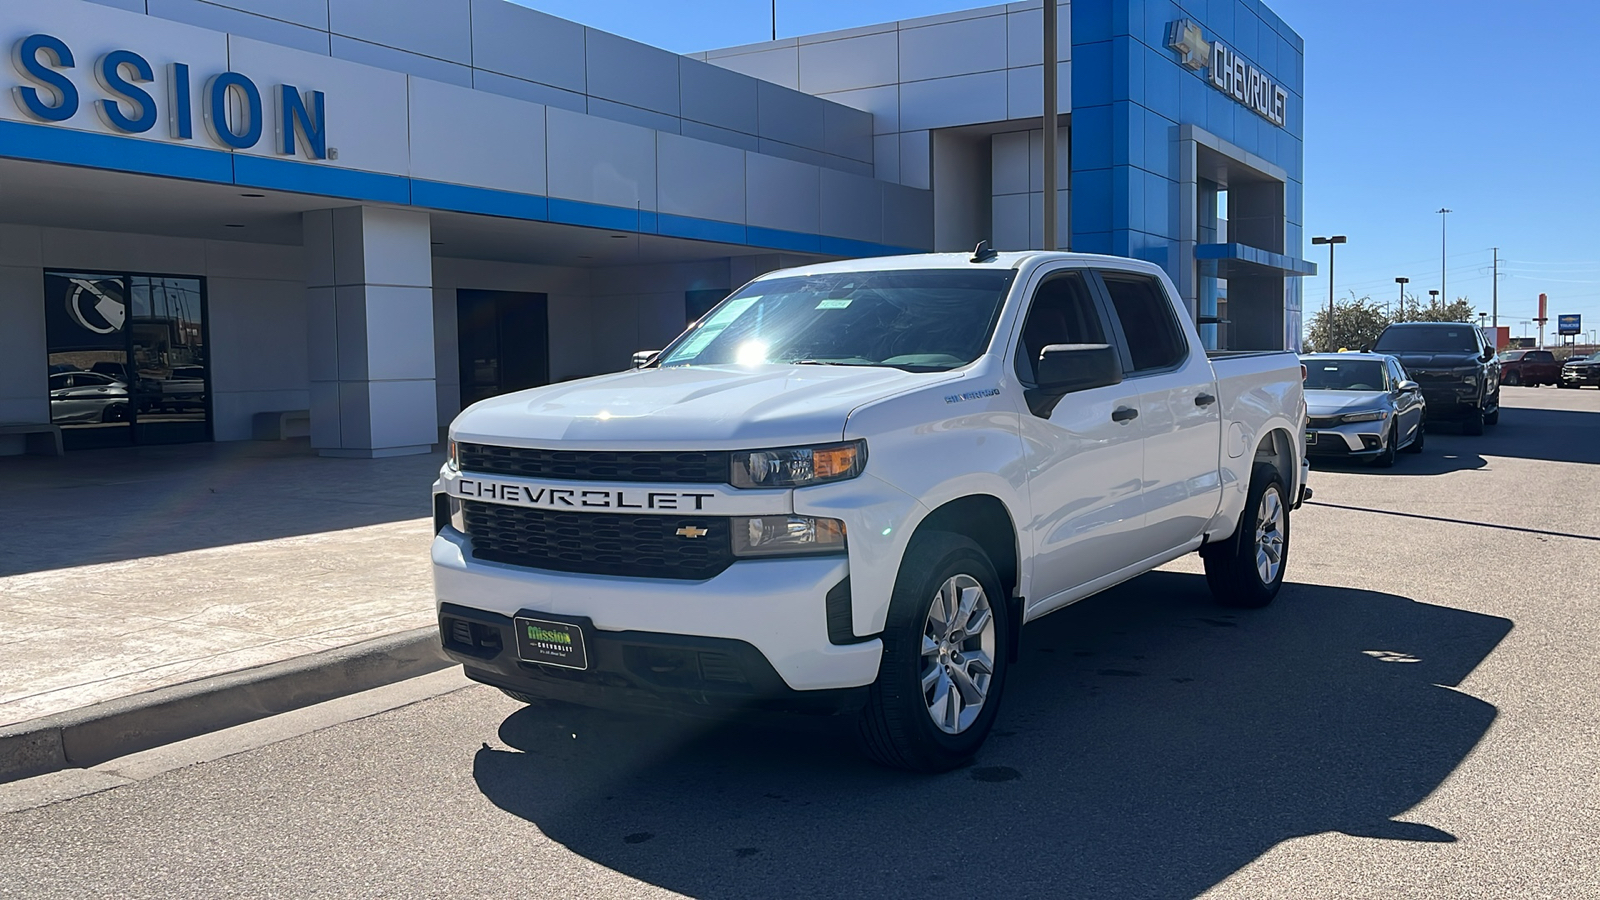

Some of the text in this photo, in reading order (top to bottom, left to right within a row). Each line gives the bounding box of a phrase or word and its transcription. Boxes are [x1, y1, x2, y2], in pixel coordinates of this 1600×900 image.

[1211, 41, 1288, 127] CHEVROLET
[944, 388, 1000, 404] SILVERADO
[459, 479, 715, 510] CHEVROLET
[537, 642, 573, 653] CHEVROLET
